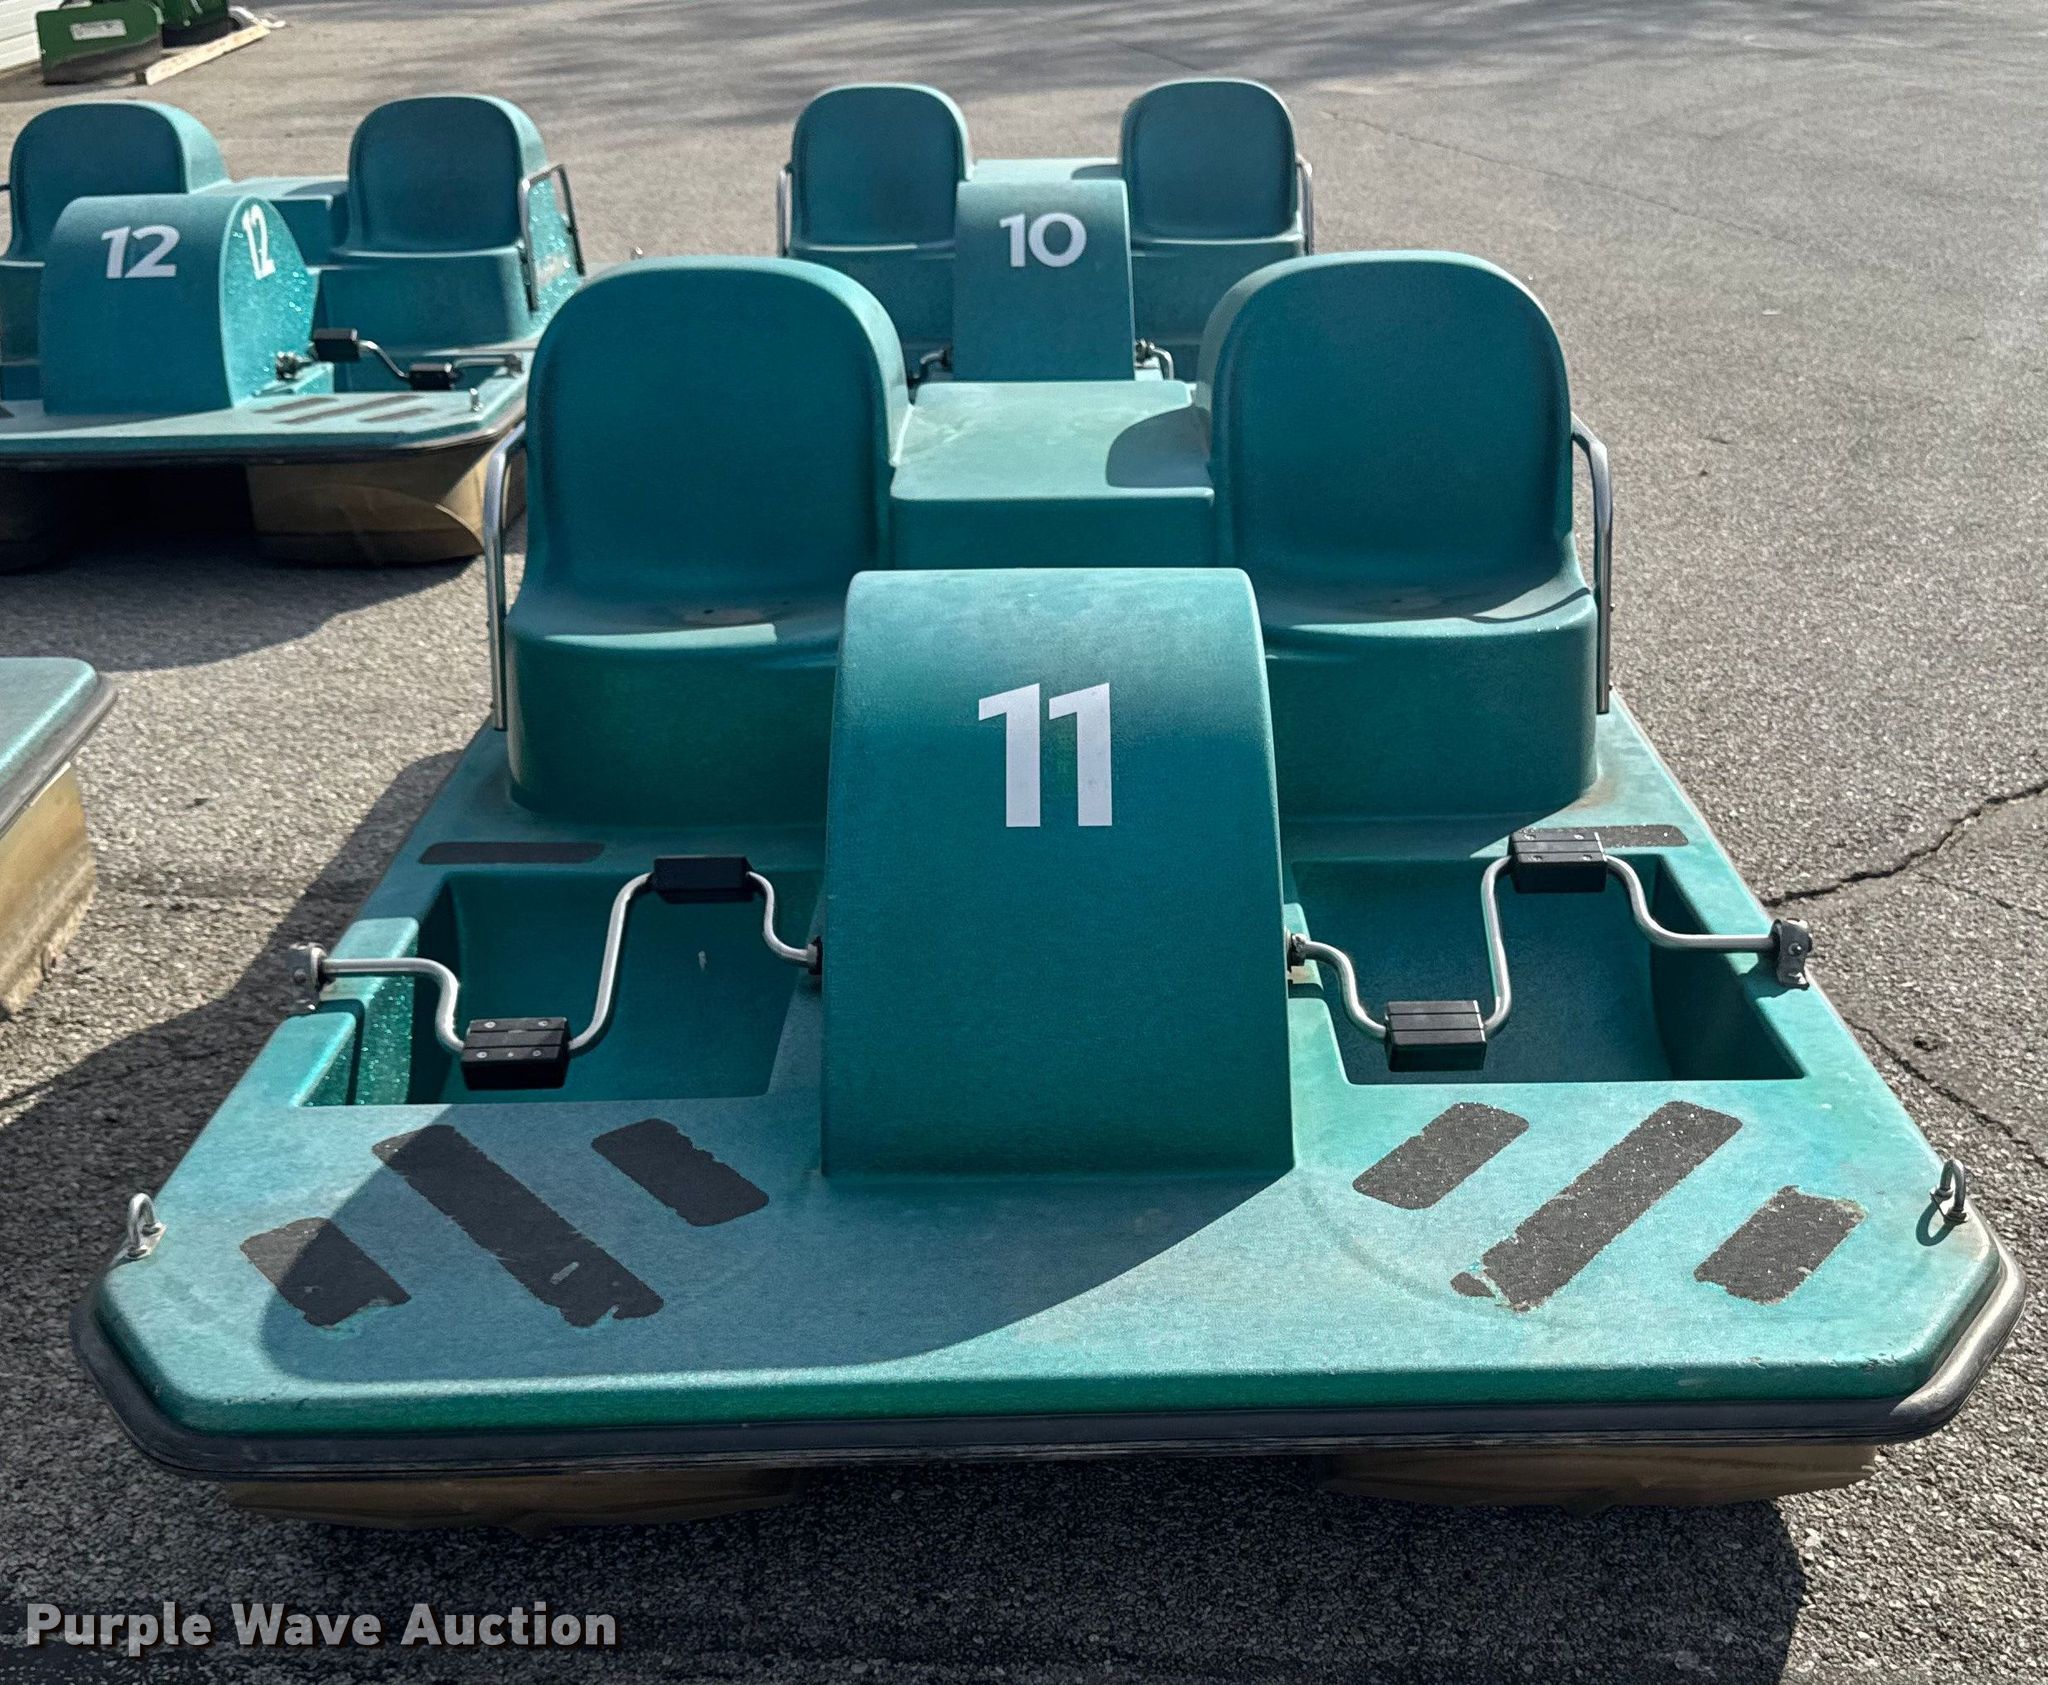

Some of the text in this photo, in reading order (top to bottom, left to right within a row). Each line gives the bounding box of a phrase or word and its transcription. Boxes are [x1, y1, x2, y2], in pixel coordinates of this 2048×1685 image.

[101, 224, 180, 279] 12
[999, 212, 1087, 268] 10
[978, 682, 1113, 828] 11
